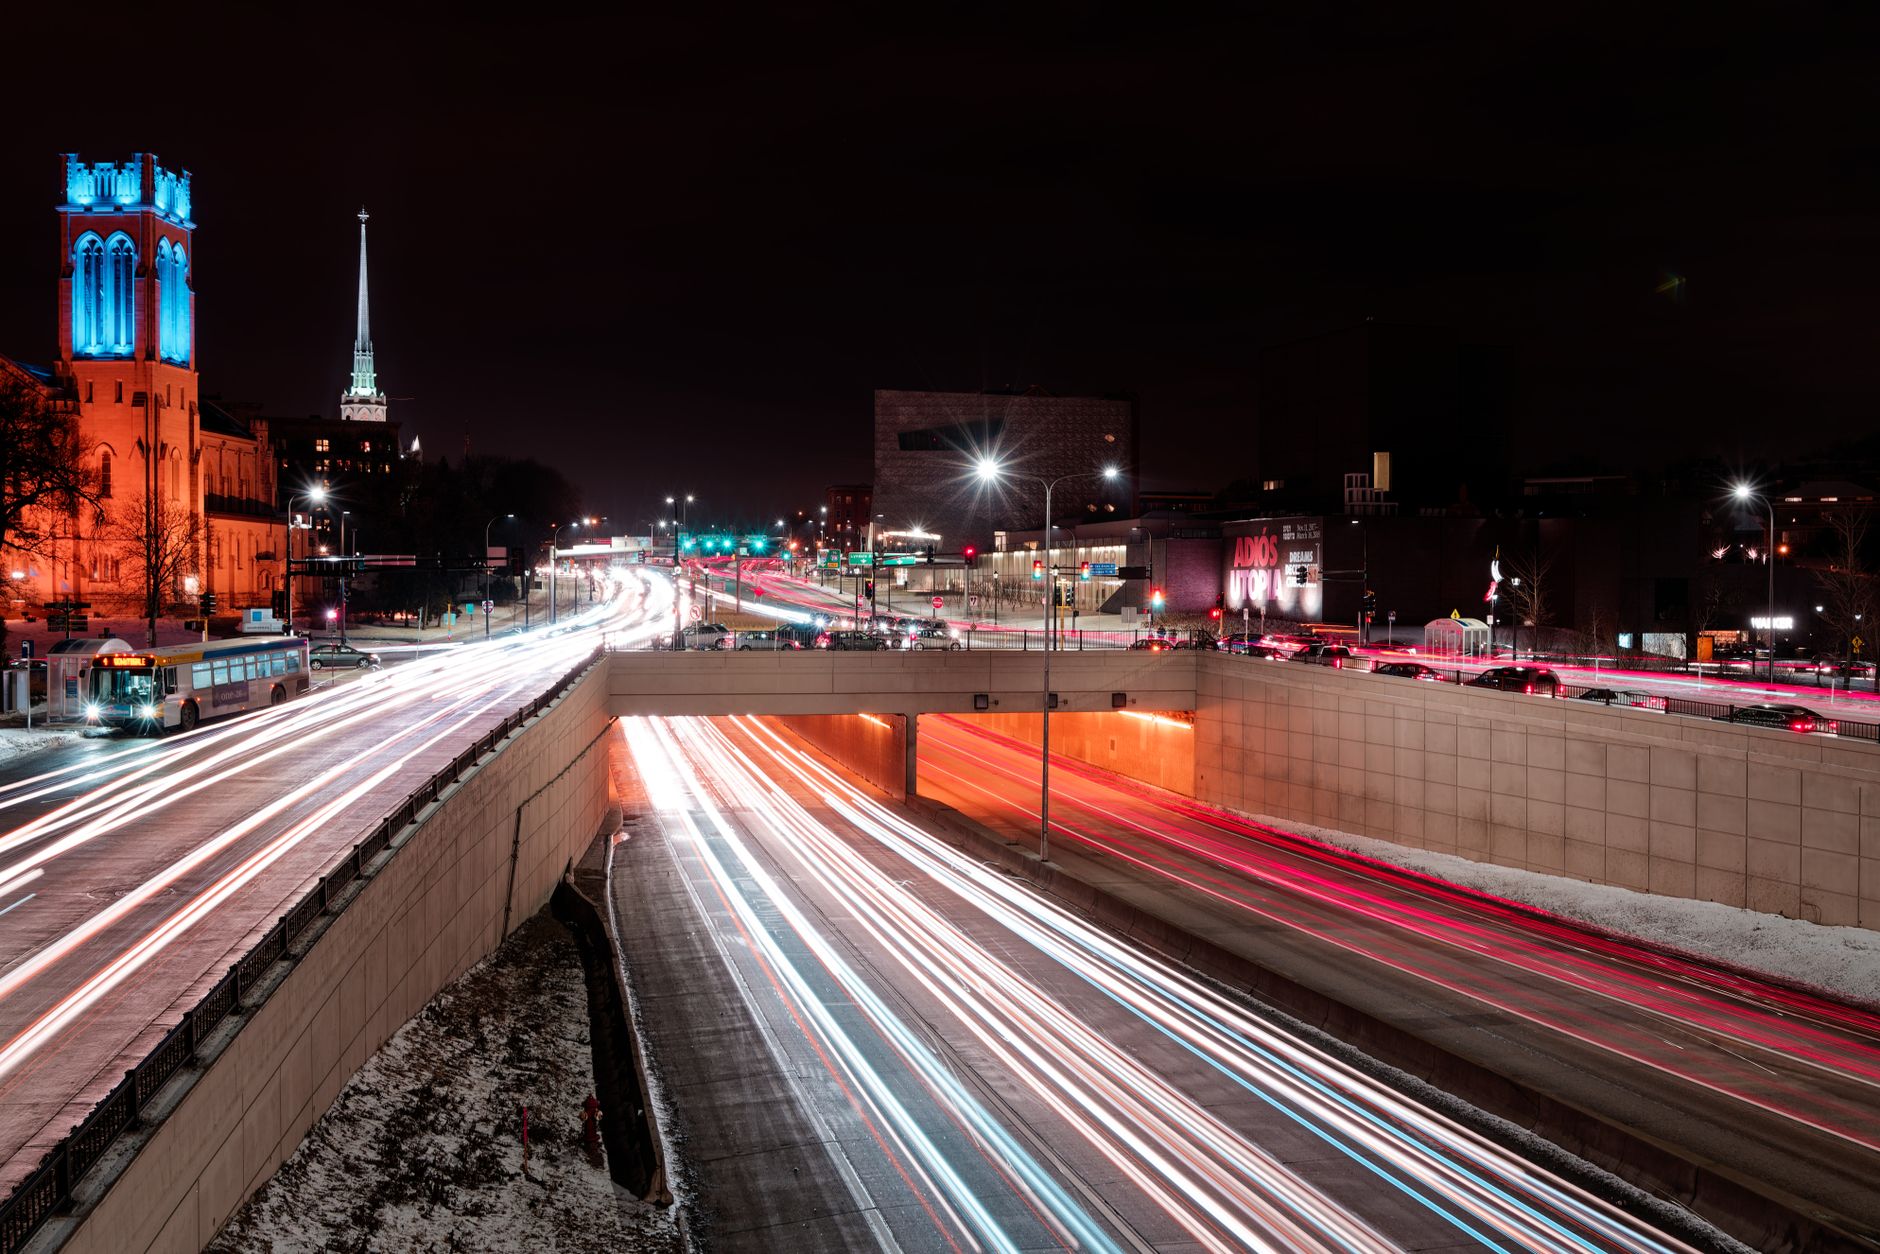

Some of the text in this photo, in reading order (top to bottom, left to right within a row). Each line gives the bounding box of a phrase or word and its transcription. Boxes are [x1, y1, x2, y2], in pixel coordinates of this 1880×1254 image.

[1234, 527, 1278, 567] ADIÓS
[1290, 551, 1313, 562] DREAMS
[1230, 569, 1283, 600] UTOPIA
[1751, 617, 1792, 629] WALKER
